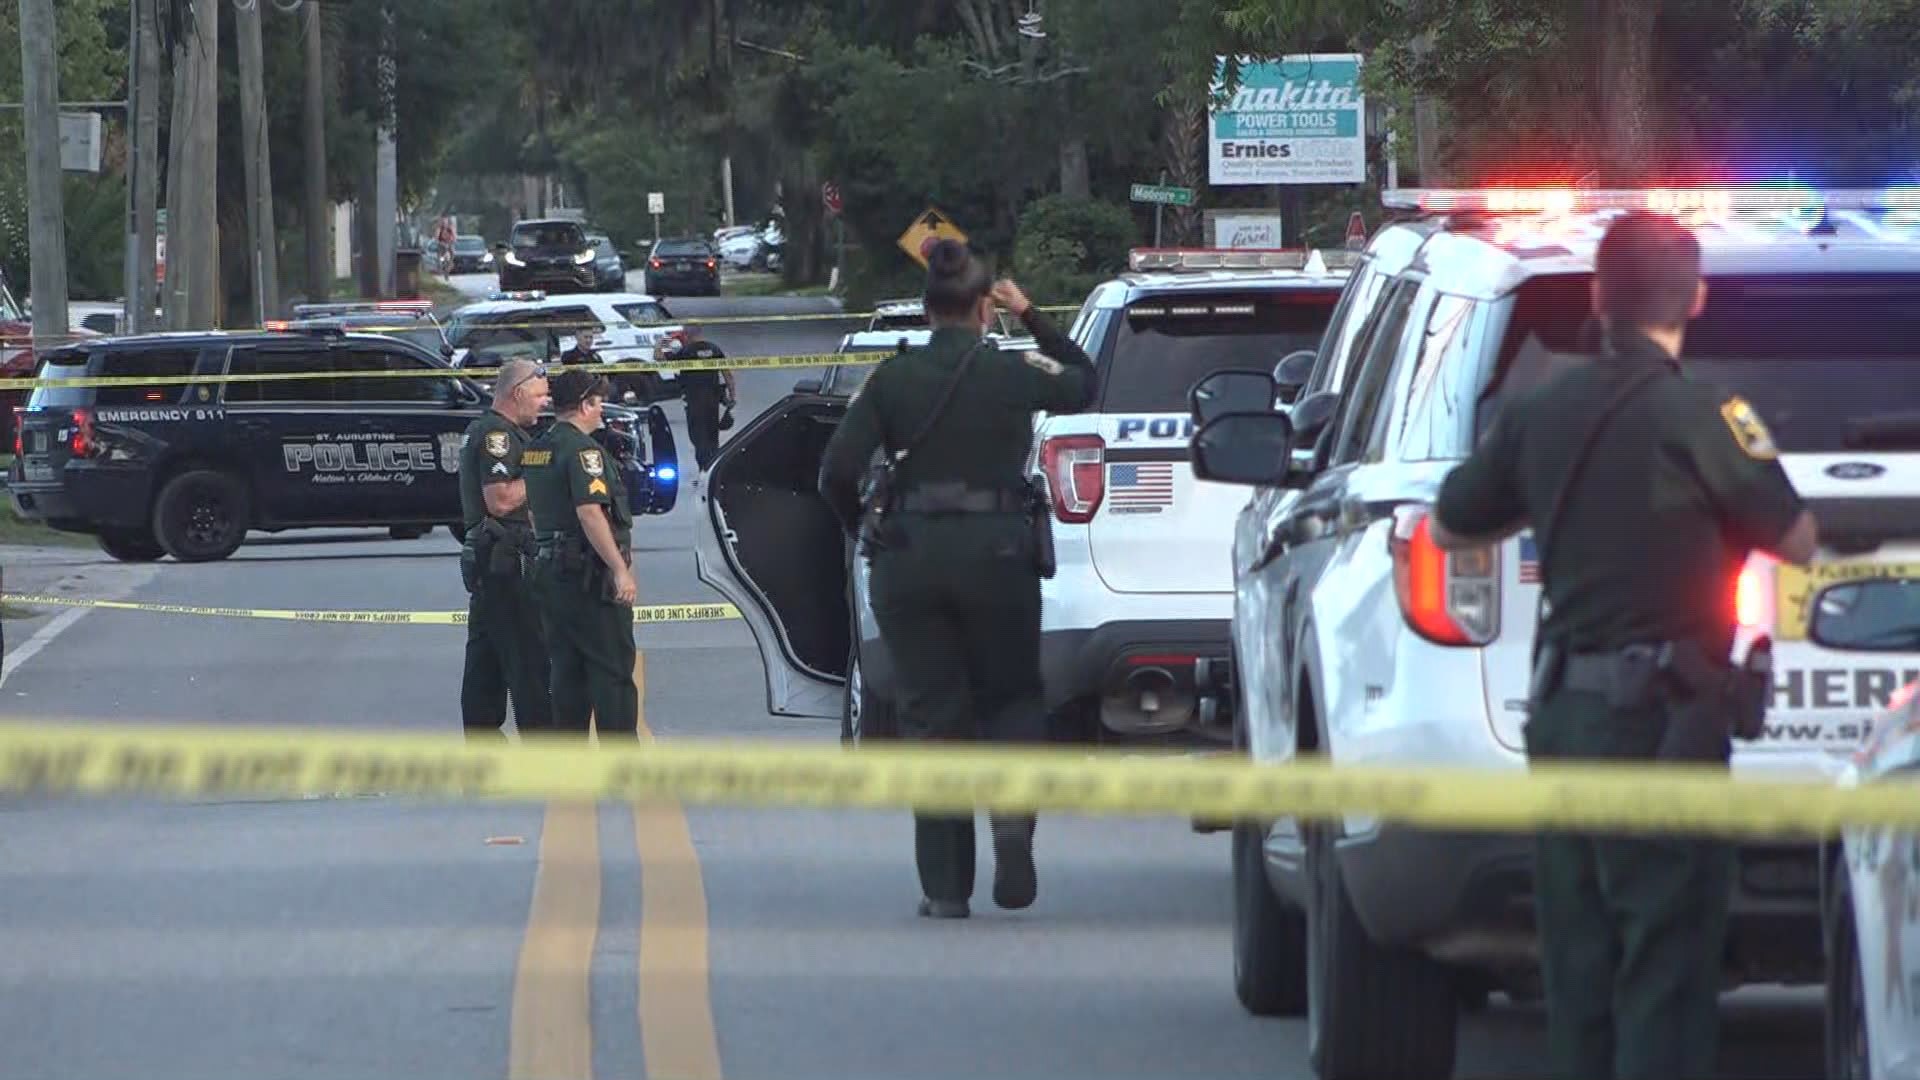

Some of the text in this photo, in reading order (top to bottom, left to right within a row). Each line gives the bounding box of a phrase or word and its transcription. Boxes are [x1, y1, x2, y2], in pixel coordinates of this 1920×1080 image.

[1236, 112, 1337, 128] POWER TOOLS
[1221, 140, 1291, 158] Ernies
[97, 409, 224, 422] EMERGENCY 911
[336, 433, 396, 441] AUGUSTINE
[282, 442, 437, 472] POLICE
[393, 473, 415, 486] City
[637, 607, 726, 620] SHERIFF'S LINE DO NOT
[1765, 669, 1918, 707] HER
